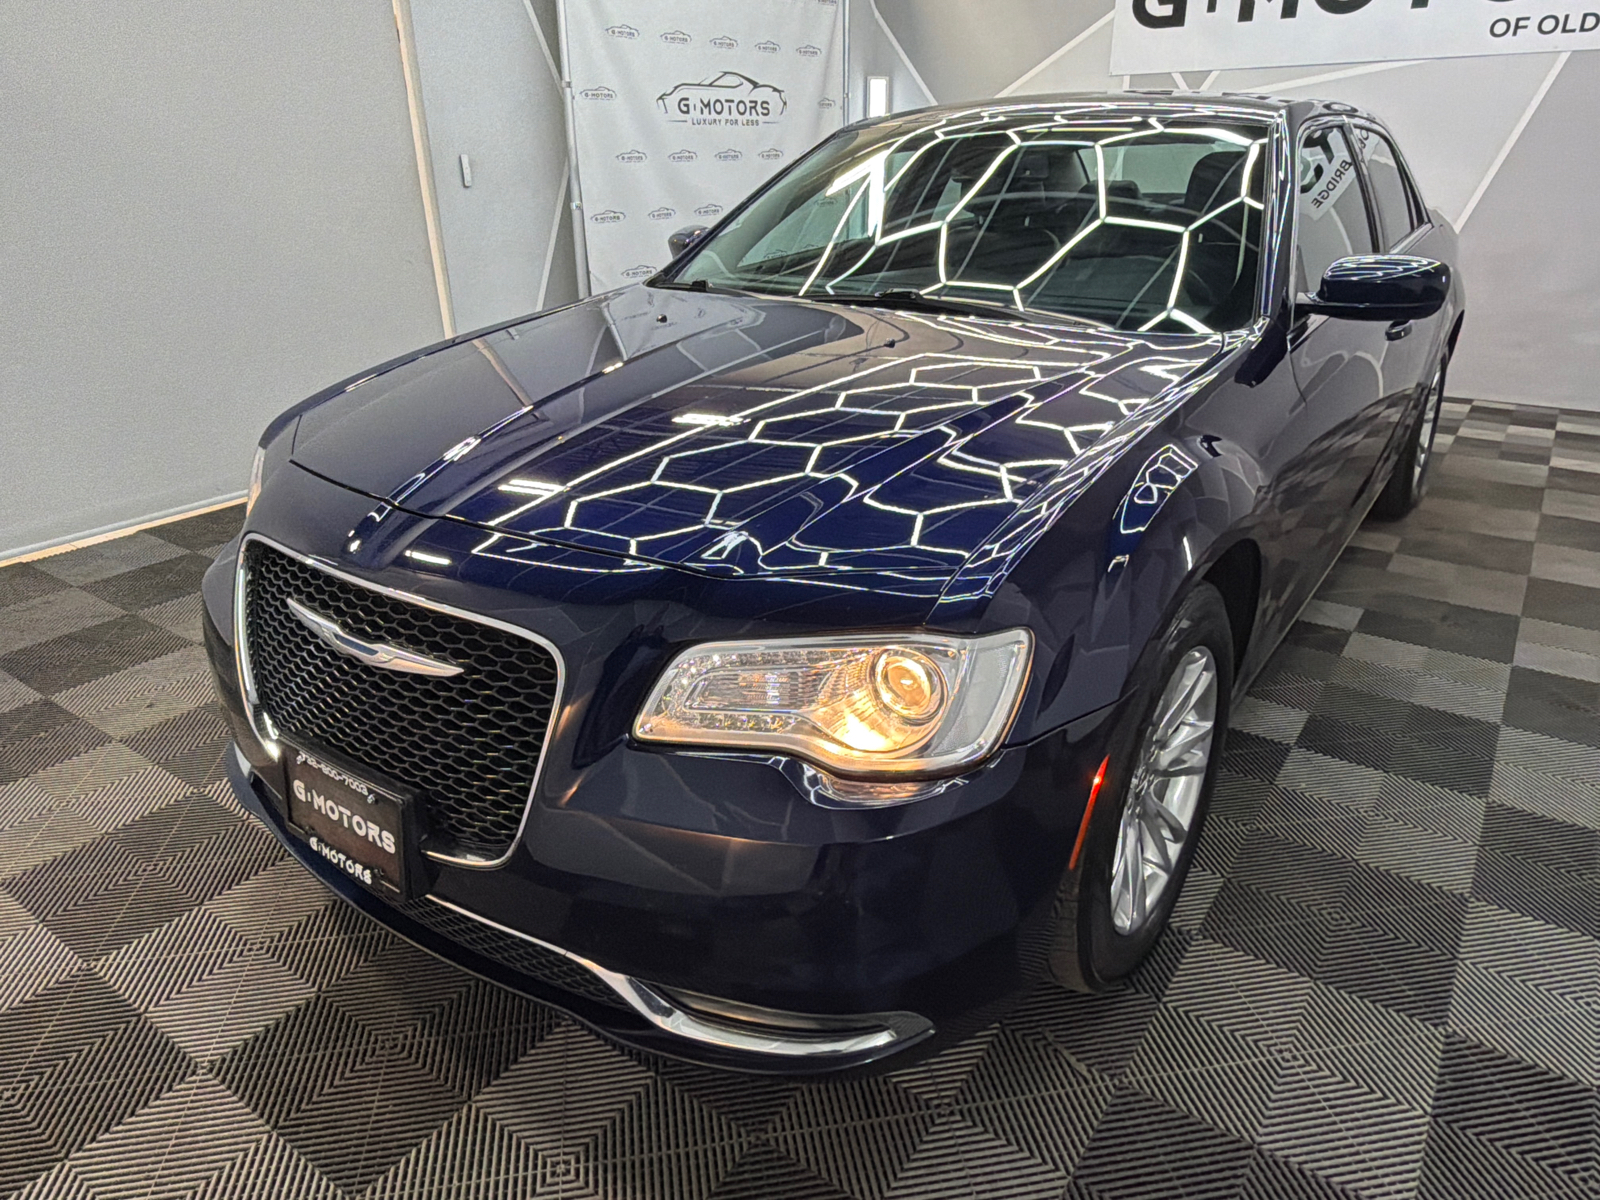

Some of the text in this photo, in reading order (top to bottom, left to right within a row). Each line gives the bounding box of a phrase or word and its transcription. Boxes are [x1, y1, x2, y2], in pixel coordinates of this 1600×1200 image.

[1489, 16, 1531, 38] OF
[1537, 12, 1600, 35] OLD
[692, 117, 760, 127] LUXURY FOR LESS
